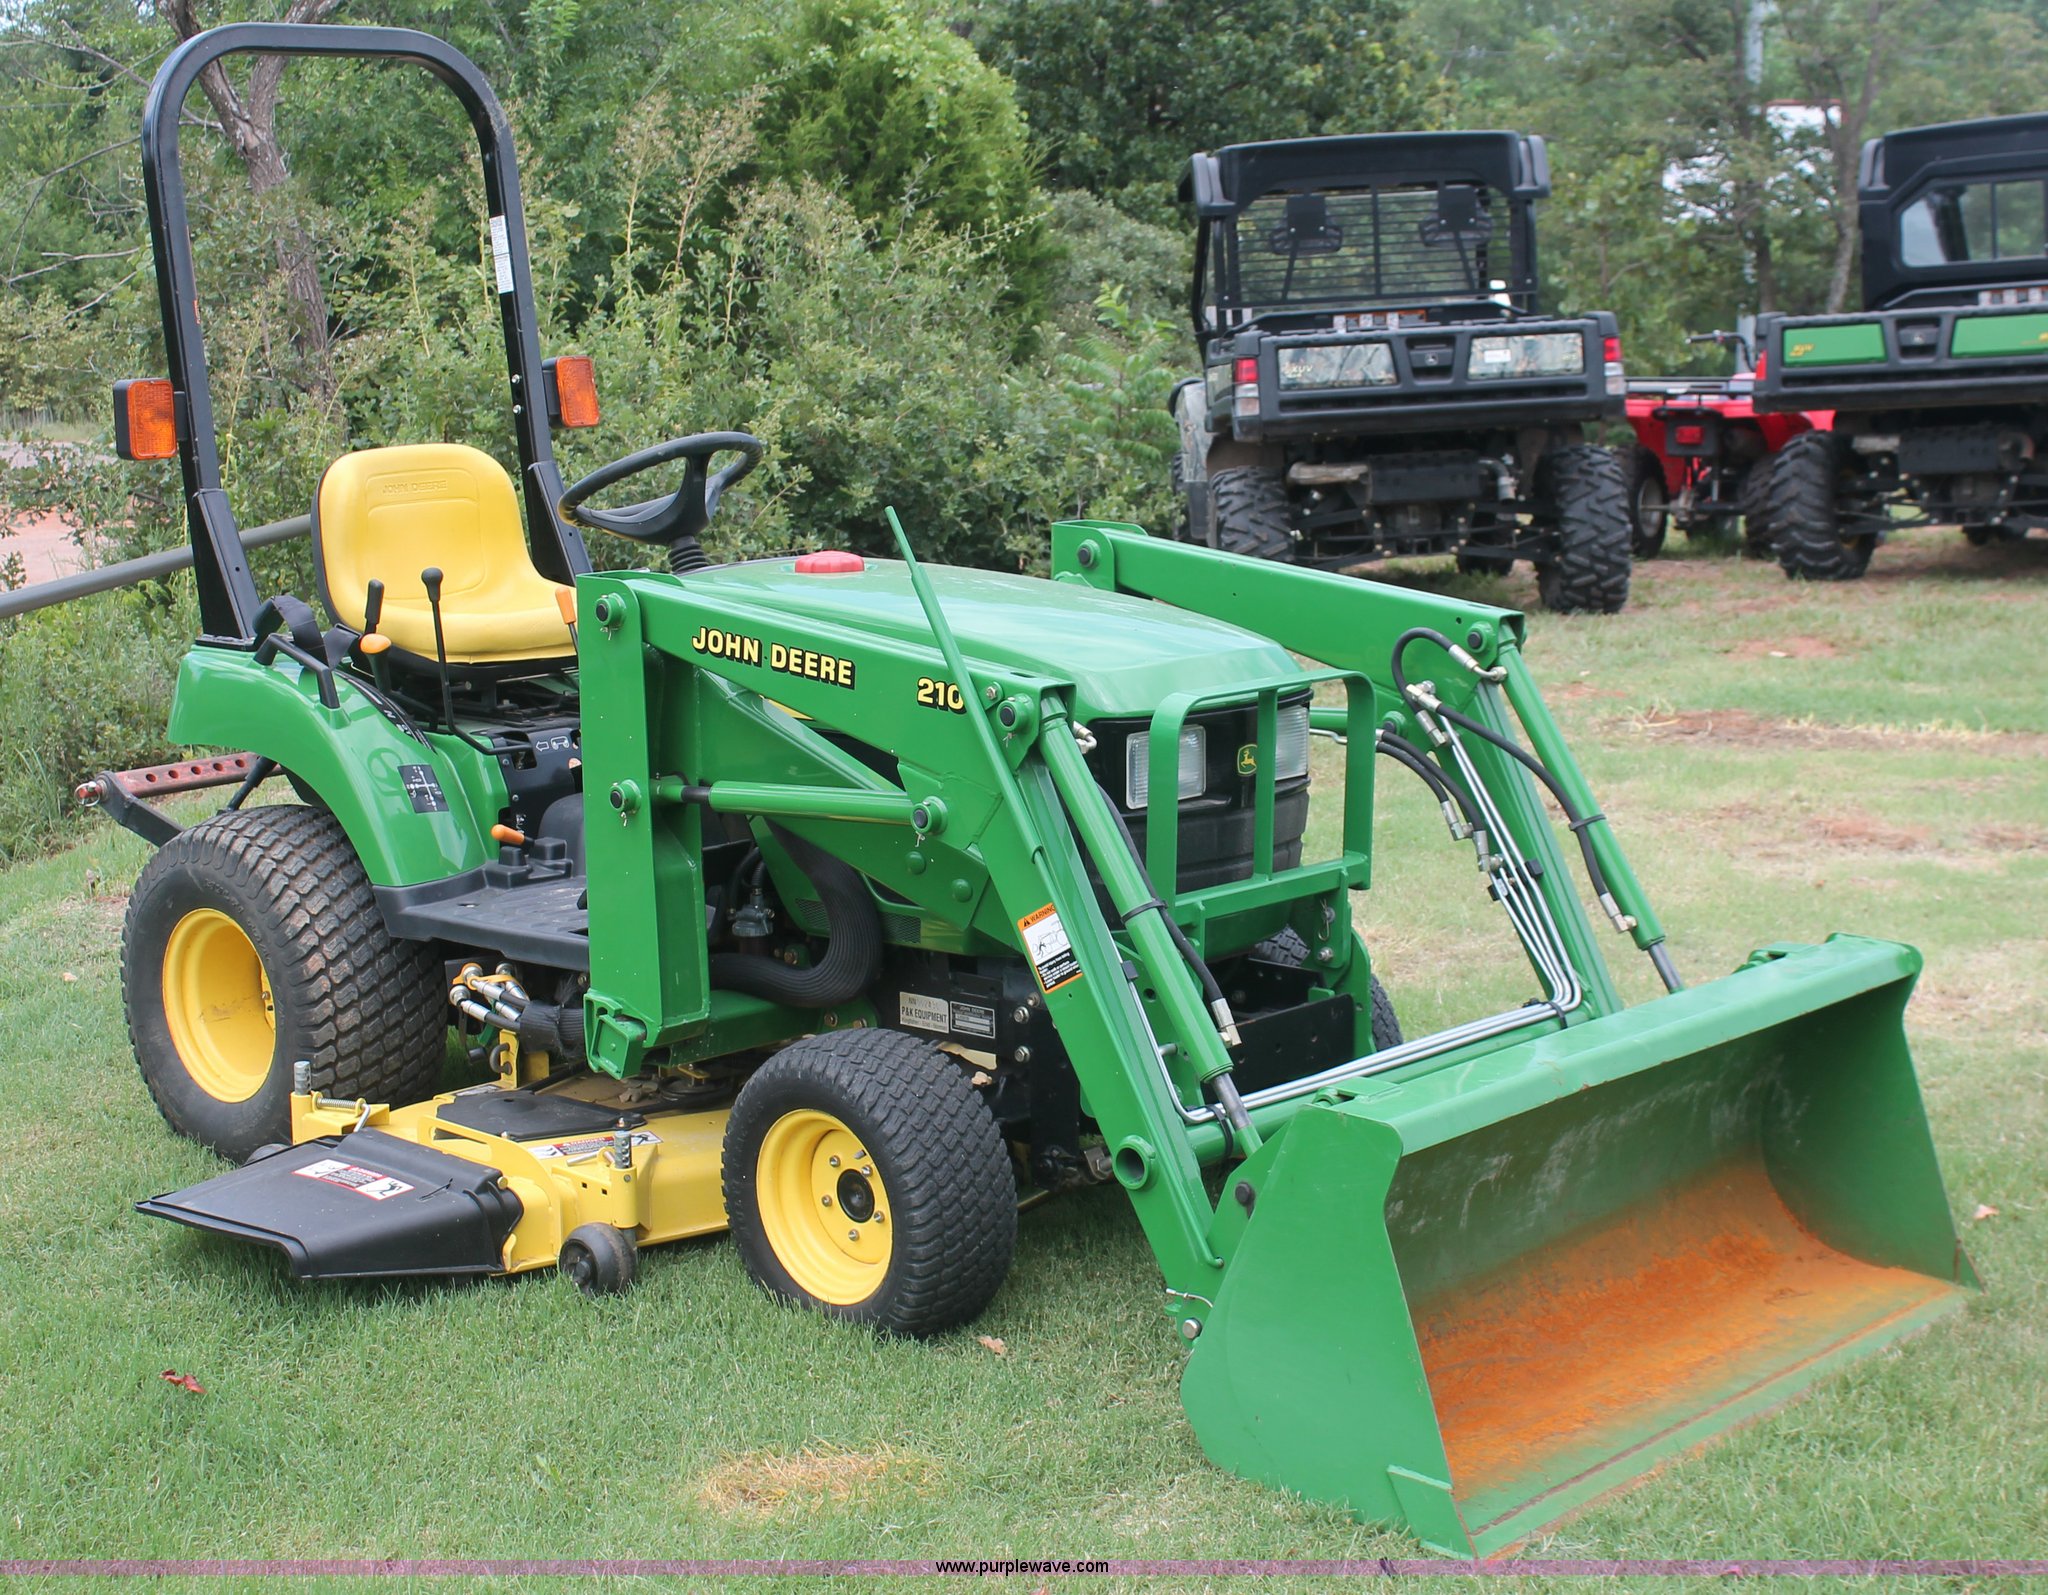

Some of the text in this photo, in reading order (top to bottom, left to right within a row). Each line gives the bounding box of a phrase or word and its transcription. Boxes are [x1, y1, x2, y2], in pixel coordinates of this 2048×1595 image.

[382, 480, 448, 495] JOHN DEERE
[691, 626, 967, 715] JOHN DEERE 210
[901, 1005, 914, 1017] P&K
[914, 1008, 948, 1024] EQUIPMENT
